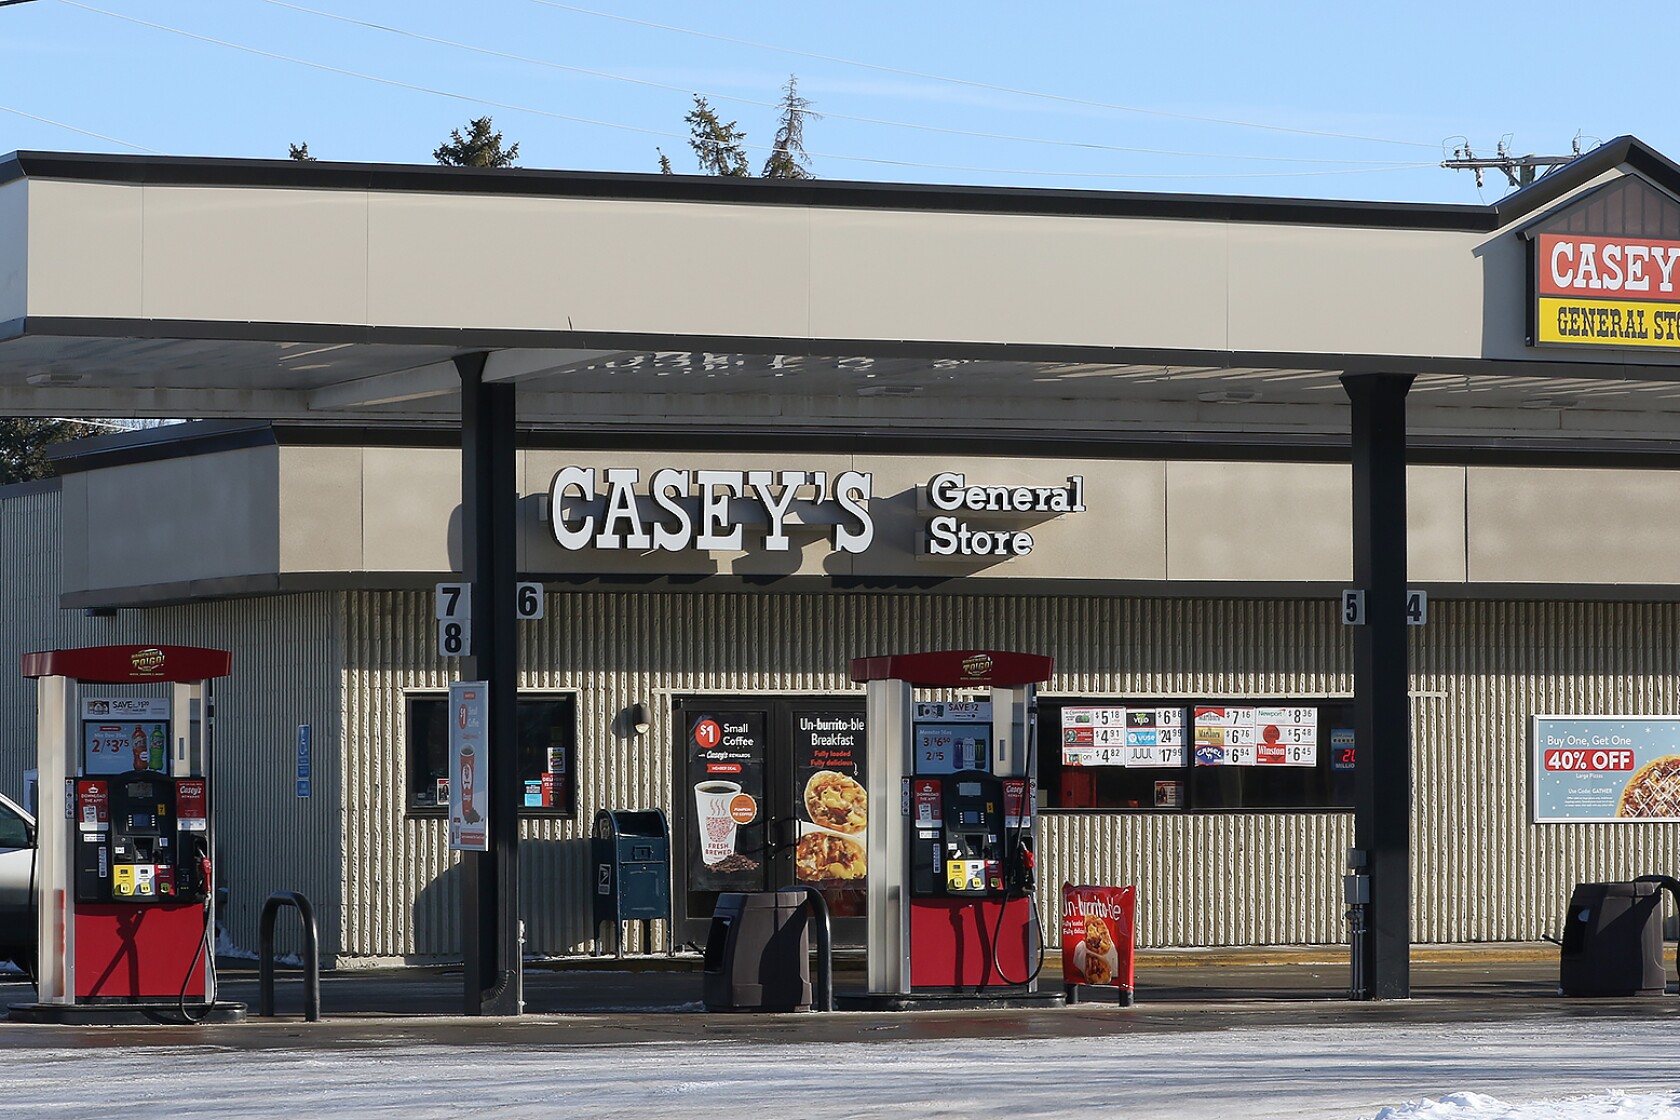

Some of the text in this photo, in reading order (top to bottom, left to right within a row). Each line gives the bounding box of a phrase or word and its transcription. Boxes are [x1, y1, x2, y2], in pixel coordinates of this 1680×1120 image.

[1551, 241, 1680, 292] CASEY
[1557, 306, 1648, 339] GENERAL
[928, 472, 1086, 513] General
[551, 466, 875, 554] CASEY'S
[930, 516, 1034, 556] Store
[442, 587, 461, 616] 7
[517, 586, 537, 616] 6
[1346, 593, 1357, 622] 5
[1407, 594, 1421, 621] 4
[444, 622, 462, 653] 8
[112, 701, 133, 709] SAVE
[948, 703, 970, 711] SAVE
[723, 723, 748, 733] Small
[800, 717, 865, 730] Un-burrito-ble
[700, 724, 715, 743] $1
[811, 733, 855, 746] Breakfast
[723, 736, 754, 746] Coffee
[1547, 735, 1631, 747] Buy One, Get One
[814, 750, 829, 758] Fully
[1131, 748, 1152, 759] JUUL
[1197, 747, 1222, 757] CAMEL
[1258, 745, 1285, 755] Winston
[810, 759, 825, 767] Fully
[1548, 751, 1631, 769] 40% OFF
[180, 785, 202, 795] Casey's
